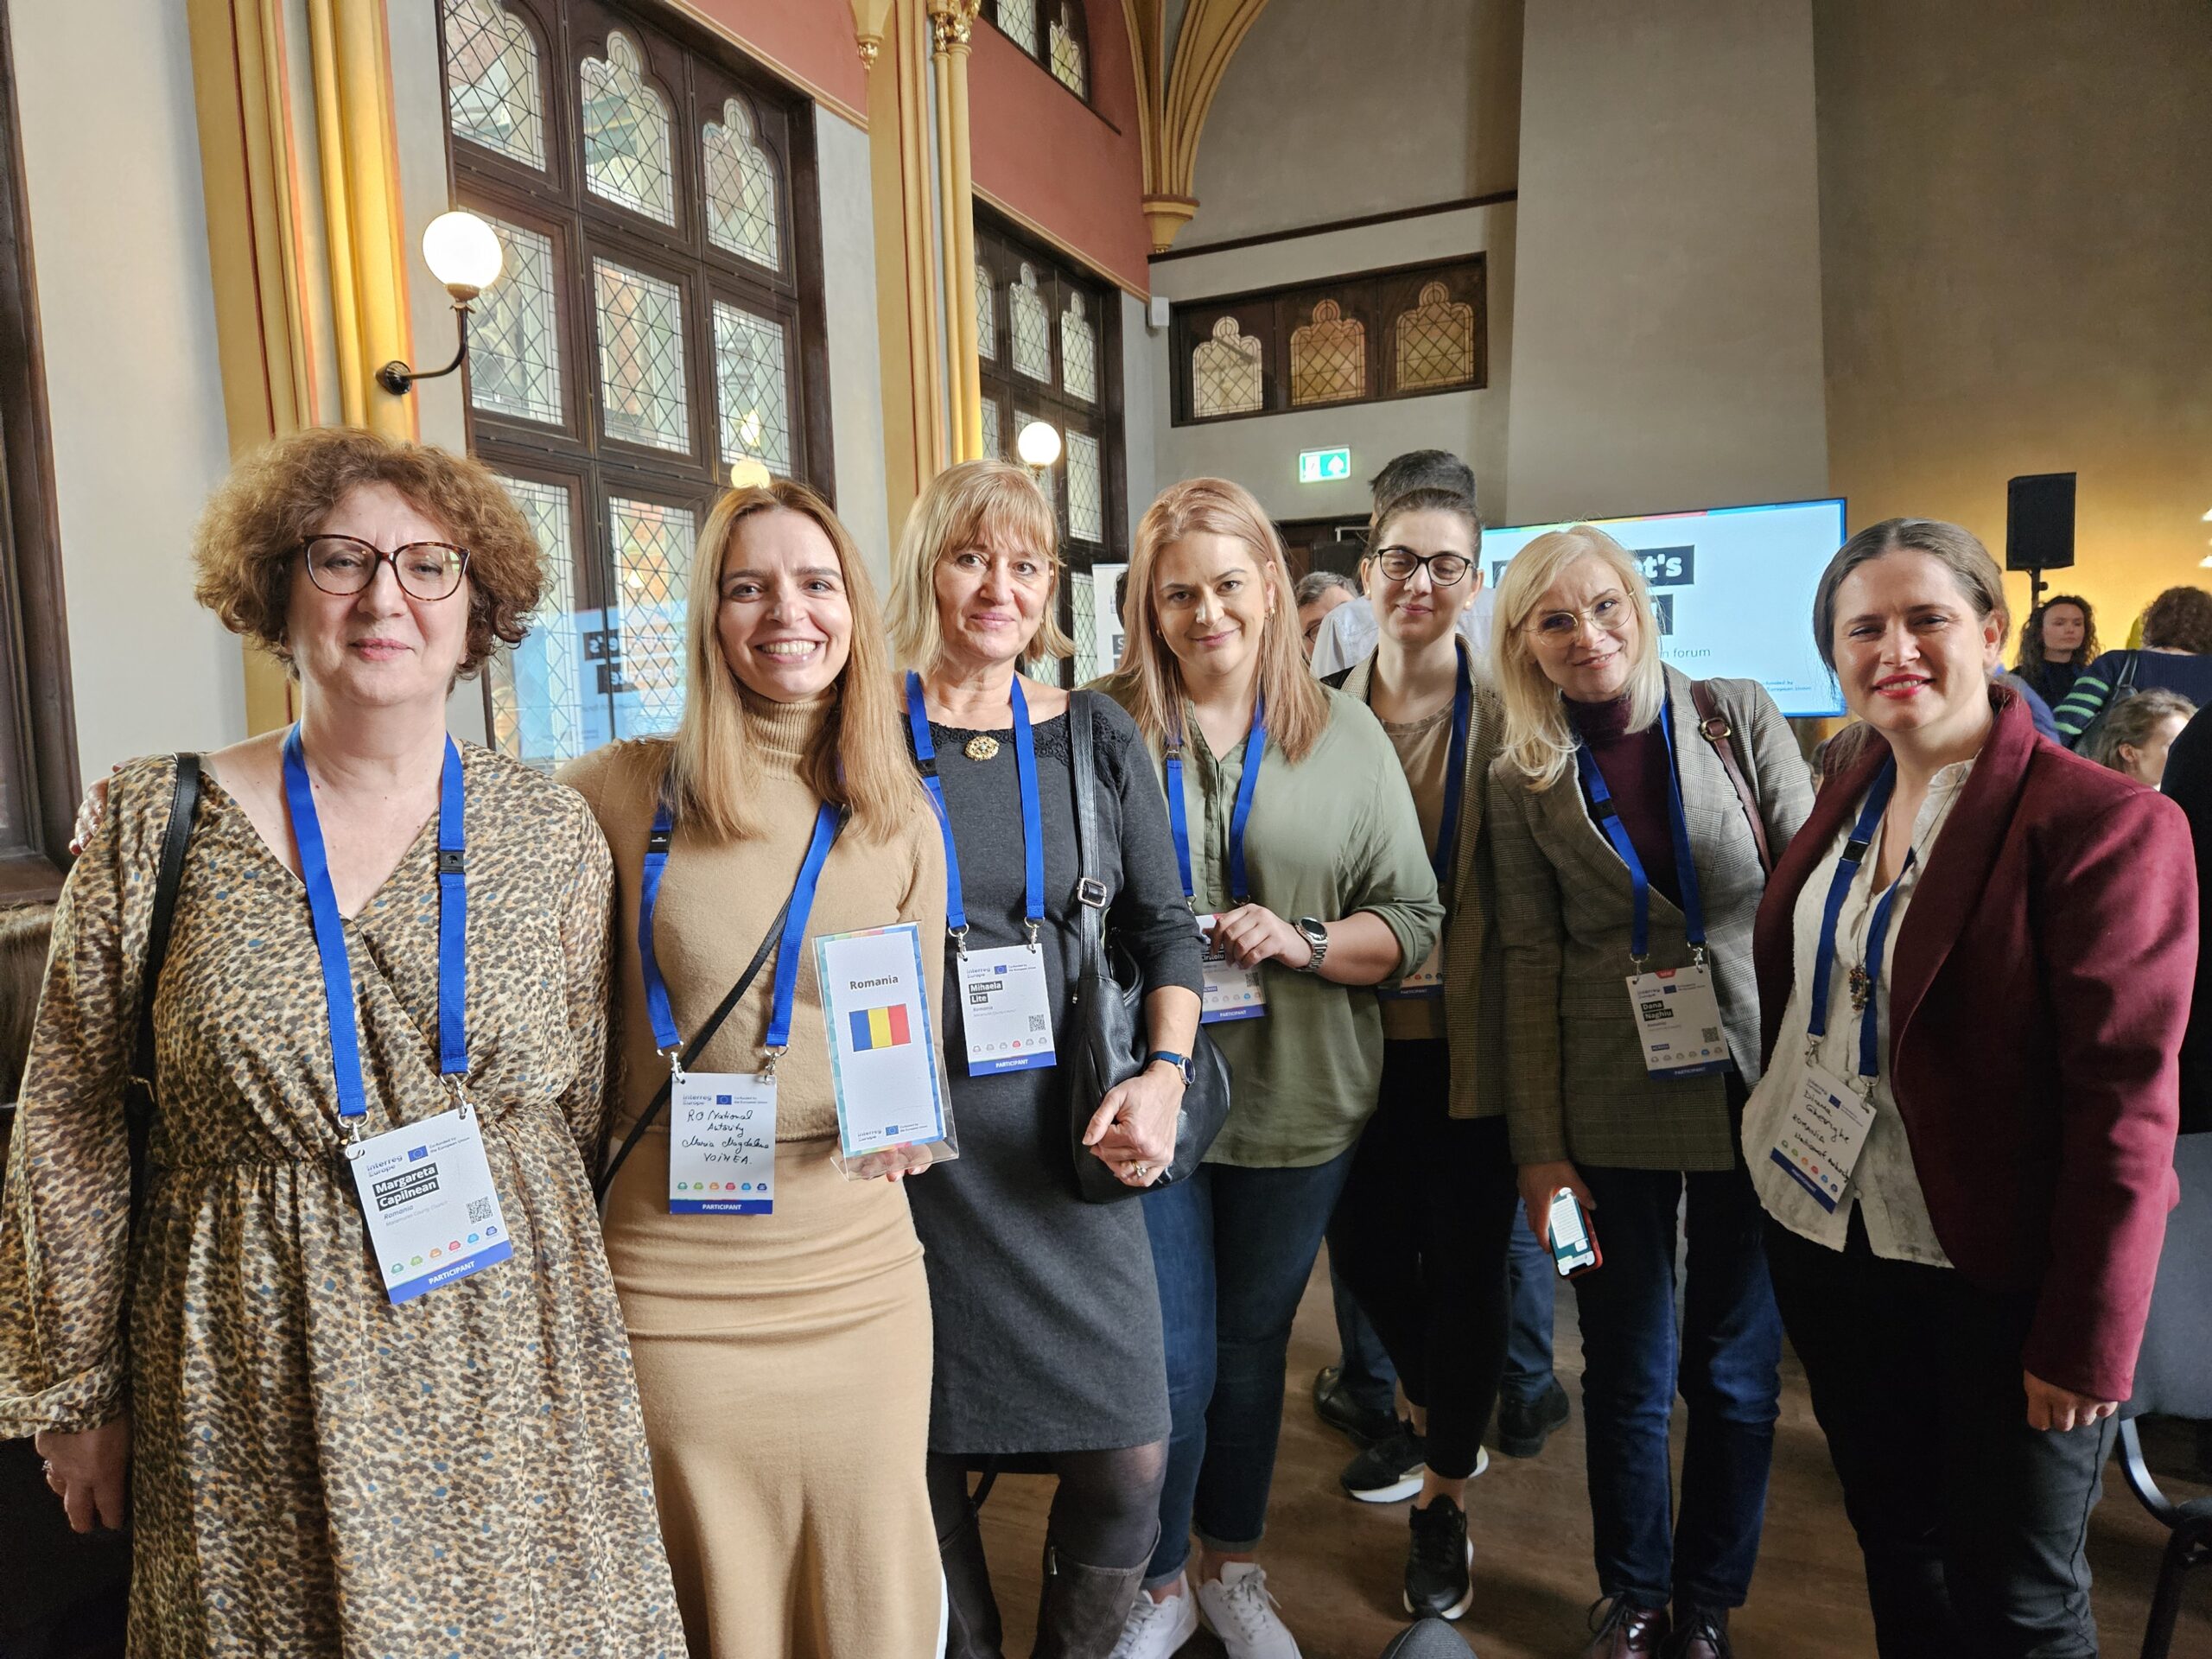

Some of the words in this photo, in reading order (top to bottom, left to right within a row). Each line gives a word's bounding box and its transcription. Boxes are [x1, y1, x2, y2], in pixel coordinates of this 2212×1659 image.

[1674, 647, 1711, 658] forum
[849, 974, 899, 991] Romania
[969, 982, 1001, 993] Mihaela
[1220, 1009, 1247, 1018] PARTICIPANT
[995, 1058, 1029, 1069] PARTICIPANT
[708, 1109, 753, 1121] National
[375, 1166, 436, 1194] Margareta
[378, 1180, 437, 1208] Capilnean
[384, 1205, 414, 1220] Romania
[702, 1203, 742, 1211] PARTICIPANT
[429, 1260, 476, 1286] PARTICIPANT
